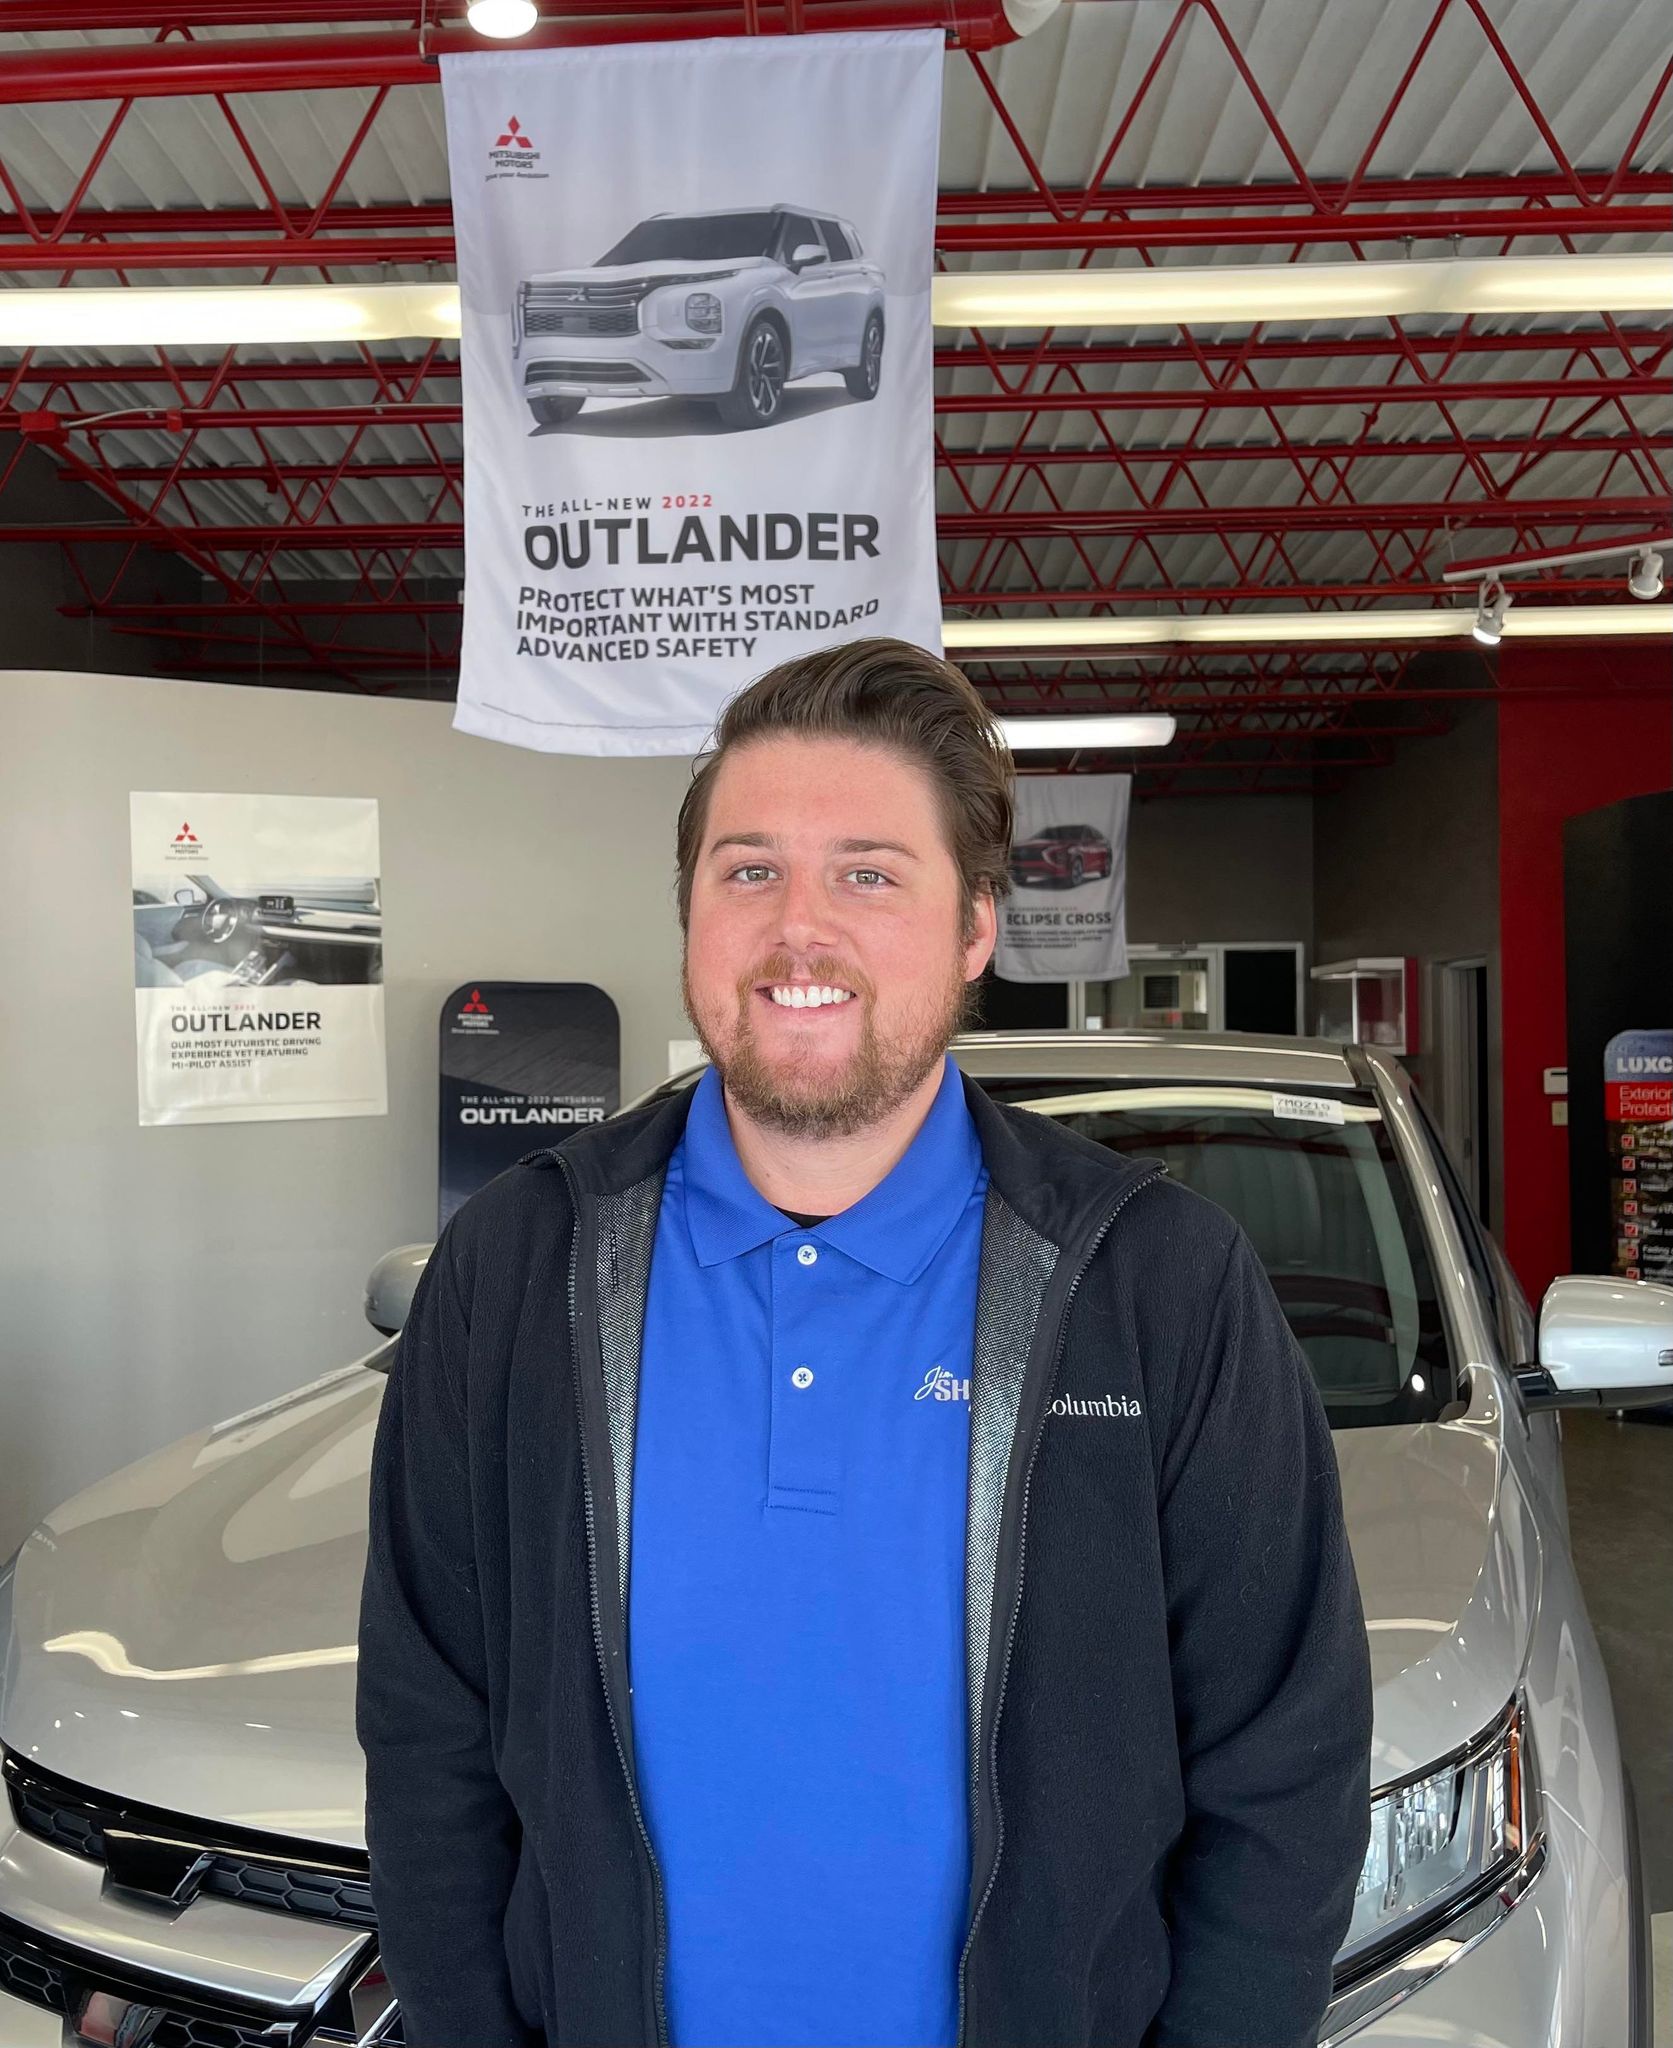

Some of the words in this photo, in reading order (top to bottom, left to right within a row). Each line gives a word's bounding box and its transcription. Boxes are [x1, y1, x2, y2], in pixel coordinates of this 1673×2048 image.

[522, 504, 555, 518] THE
[561, 497, 651, 516] ALL-NEW
[662, 494, 713, 509] 2022
[524, 512, 880, 570] OUTLANDER
[519, 586, 625, 613] PROTECT
[631, 584, 732, 607] WHAT'S
[741, 584, 815, 605] MOST
[517, 610, 662, 638] IMPORTANT
[668, 611, 737, 633] WITH
[744, 598, 879, 632] STANDARD
[516, 636, 649, 662] ADVANCED
[656, 637, 757, 658] SAFETY
[1006, 913, 1062, 926] ECLIPSE
[1066, 912, 1112, 926] CROSS
[171, 1012, 321, 1033] OUTLANDER
[171, 1040, 192, 1050] OUR
[194, 1039, 222, 1049] MOST
[224, 1038, 280, 1048] FUTURISTIC
[282, 1037, 322, 1047] DRIVING
[171, 1049, 232, 1060] EXPERIENCE
[234, 1049, 252, 1059] YET
[255, 1047, 309, 1057] FEATURING
[219, 1059, 252, 1069] ASSIST
[460, 1096, 479, 1105] THE
[481, 1096, 525, 1105] ALL-NEW
[1620, 1085, 1673, 1101] Exterior
[460, 1108, 606, 1125] OUTLANDER
[914, 1365, 953, 1400] Jim
[934, 1379, 971, 1401] SH
[1046, 1393, 1142, 1417] olumbia
